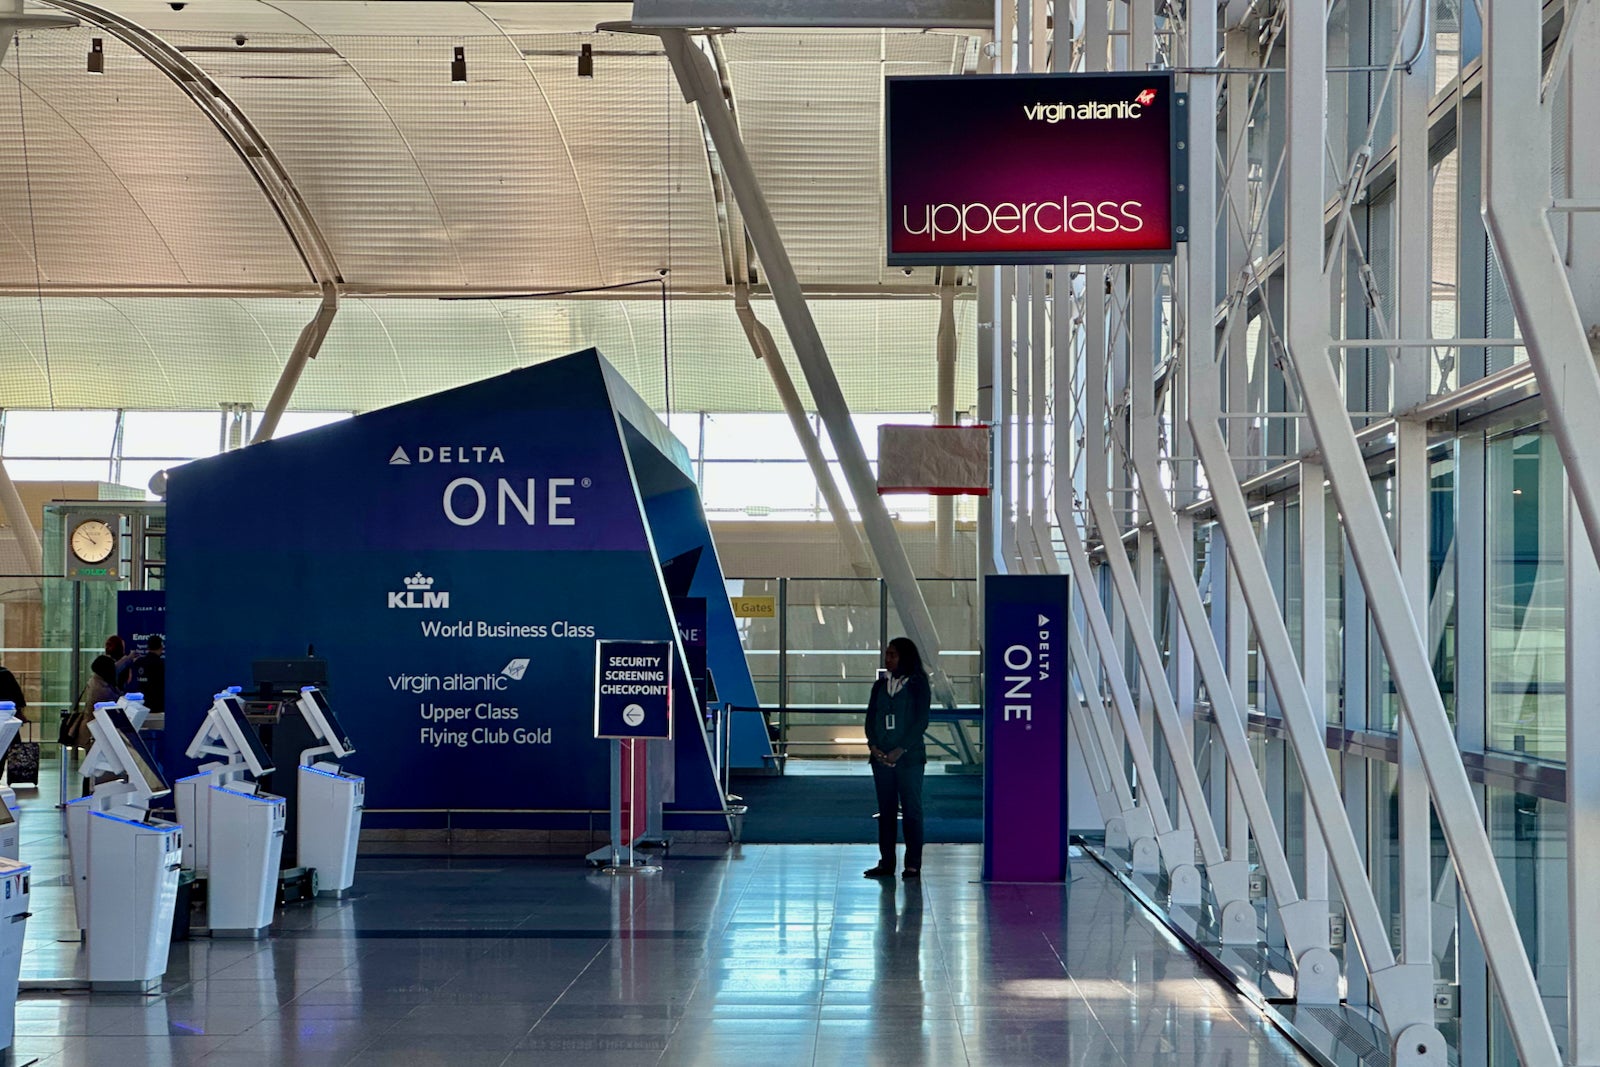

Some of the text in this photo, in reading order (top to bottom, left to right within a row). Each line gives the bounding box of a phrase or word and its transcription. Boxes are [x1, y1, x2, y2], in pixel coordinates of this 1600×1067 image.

[1024, 101, 1142, 123] virgin atlantic
[904, 196, 1143, 241] upperclass
[419, 447, 504, 462] DELTA
[388, 592, 449, 608] KLM
[741, 602, 772, 612] Gates
[421, 621, 595, 637] World Business Class
[679, 629, 698, 641] NE
[609, 656, 661, 667] SECURITY
[1039, 631, 1050, 681] DELTA
[389, 673, 508, 693] virgin atlantic
[605, 670, 664, 682] SCREENING
[601, 684, 667, 696] CHECKPOINT
[421, 703, 518, 722] Upper Class
[421, 728, 551, 747] Flying Club Gold
